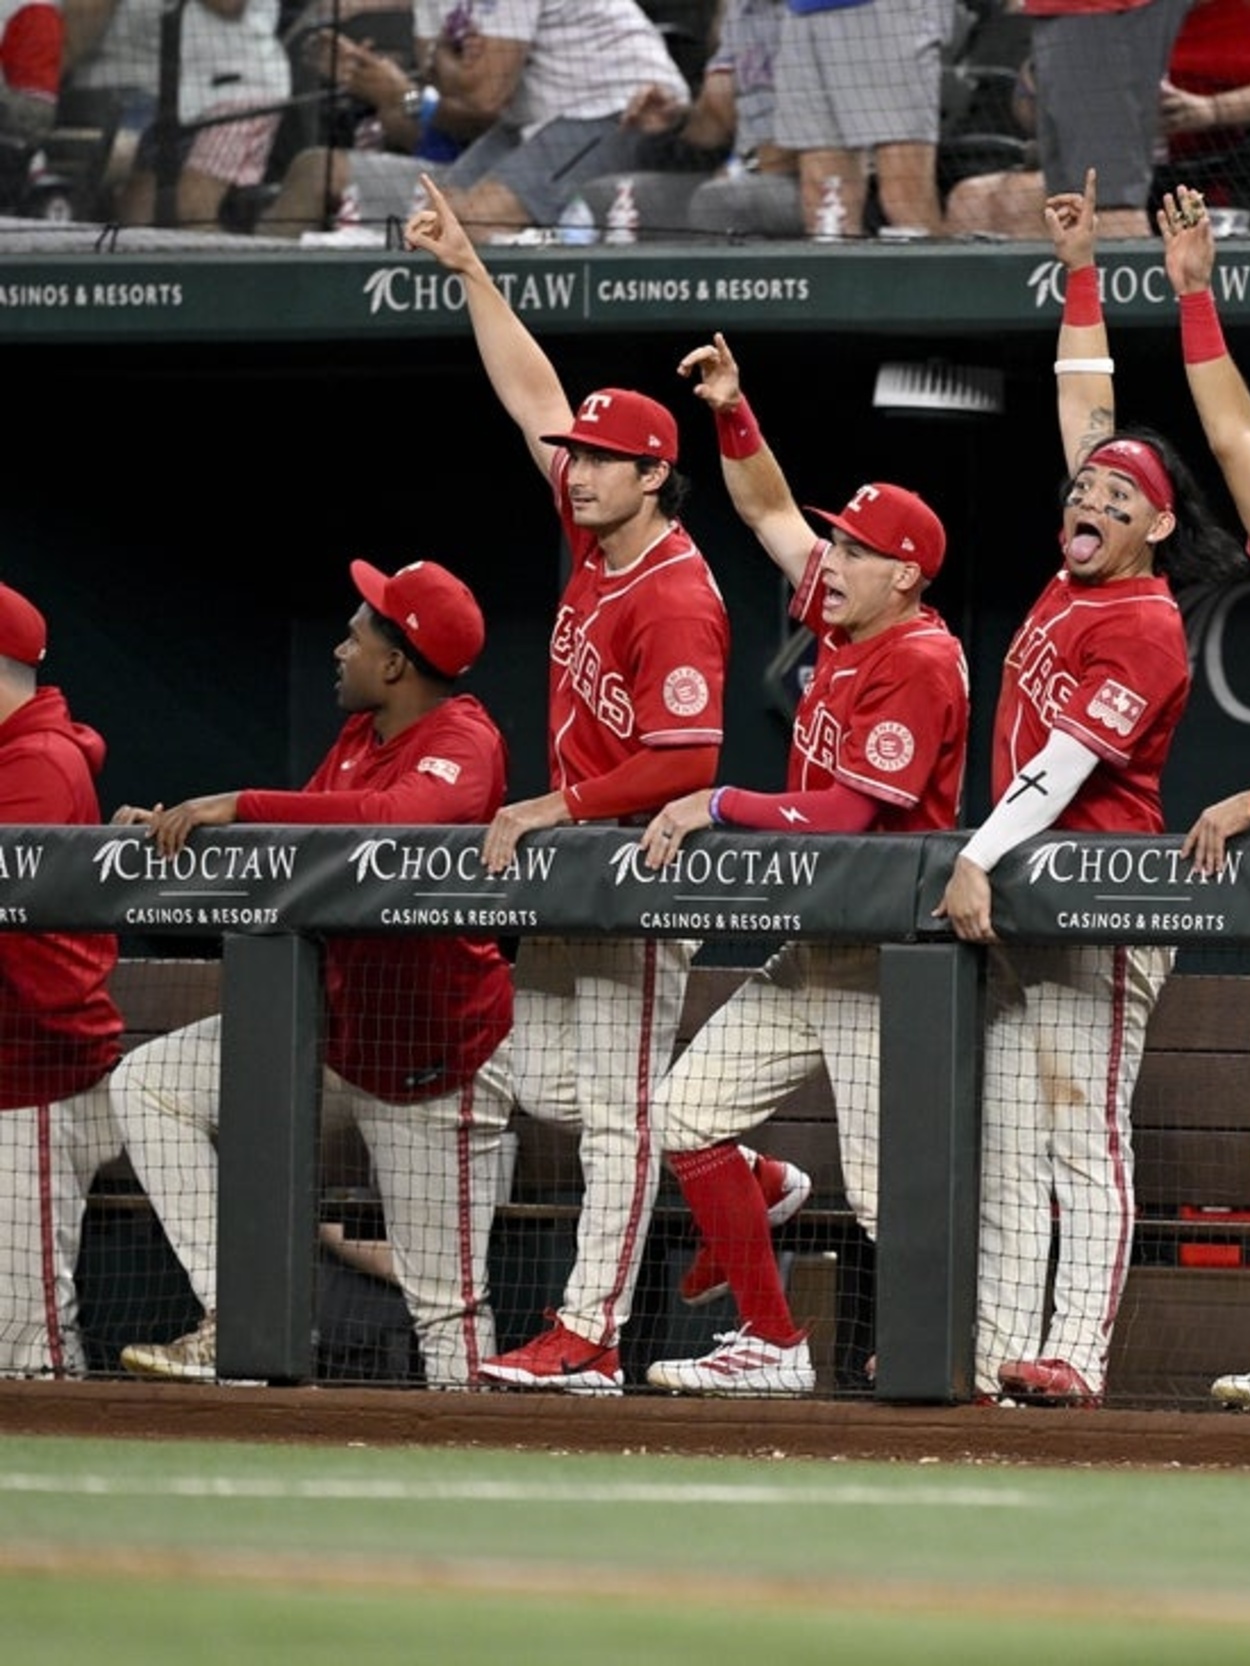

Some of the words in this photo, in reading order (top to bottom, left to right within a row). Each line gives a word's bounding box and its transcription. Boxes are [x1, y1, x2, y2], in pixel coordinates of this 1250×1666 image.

[75, 284, 89, 306] &
[94, 284, 183, 305] RESORTS
[384, 266, 577, 312] CHOTAW
[598, 279, 691, 302] CASINOS
[696, 280, 709, 301] &
[715, 278, 809, 301] RESORTS
[579, 393, 612, 422] T
[114, 838, 298, 881] CHOCTAW
[369, 838, 558, 882] CHOCAW
[126, 907, 193, 925] CASINOS
[198, 908, 208, 924] &
[212, 907, 279, 924] RESORTS
[380, 908, 450, 925] CASINOS
[454, 910, 464, 925] &
[468, 910, 538, 927] RESORTS
[640, 912, 711, 929] CASINOS
[715, 913, 725, 929] &
[730, 914, 802, 931] RESORTS
[1057, 911, 1131, 929] CASINOS
[1136, 913, 1146, 929] &
[1151, 913, 1225, 931] RESORTS
